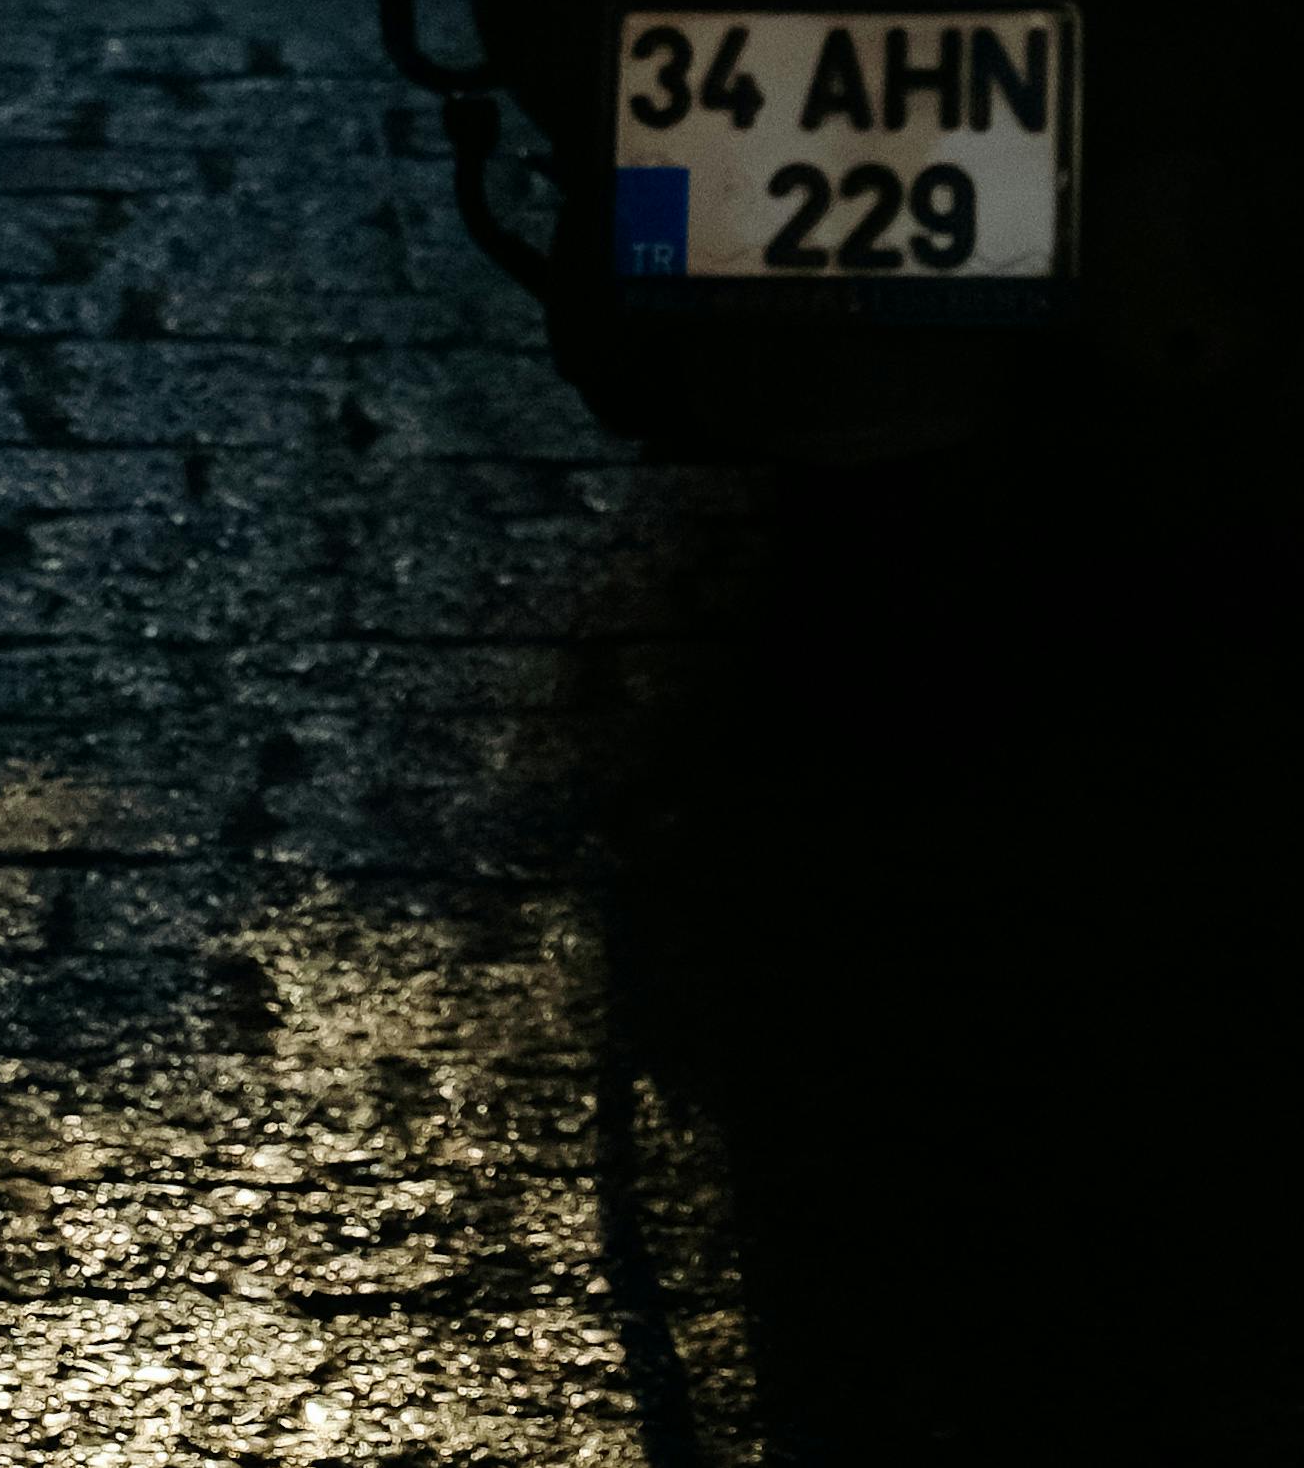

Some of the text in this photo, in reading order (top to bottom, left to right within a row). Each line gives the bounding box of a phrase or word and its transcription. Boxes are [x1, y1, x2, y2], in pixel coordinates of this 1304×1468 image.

[629, 25, 1048, 133] 34 AHN
[633, 241, 675, 275] TR
[763, 162, 978, 271] 229
